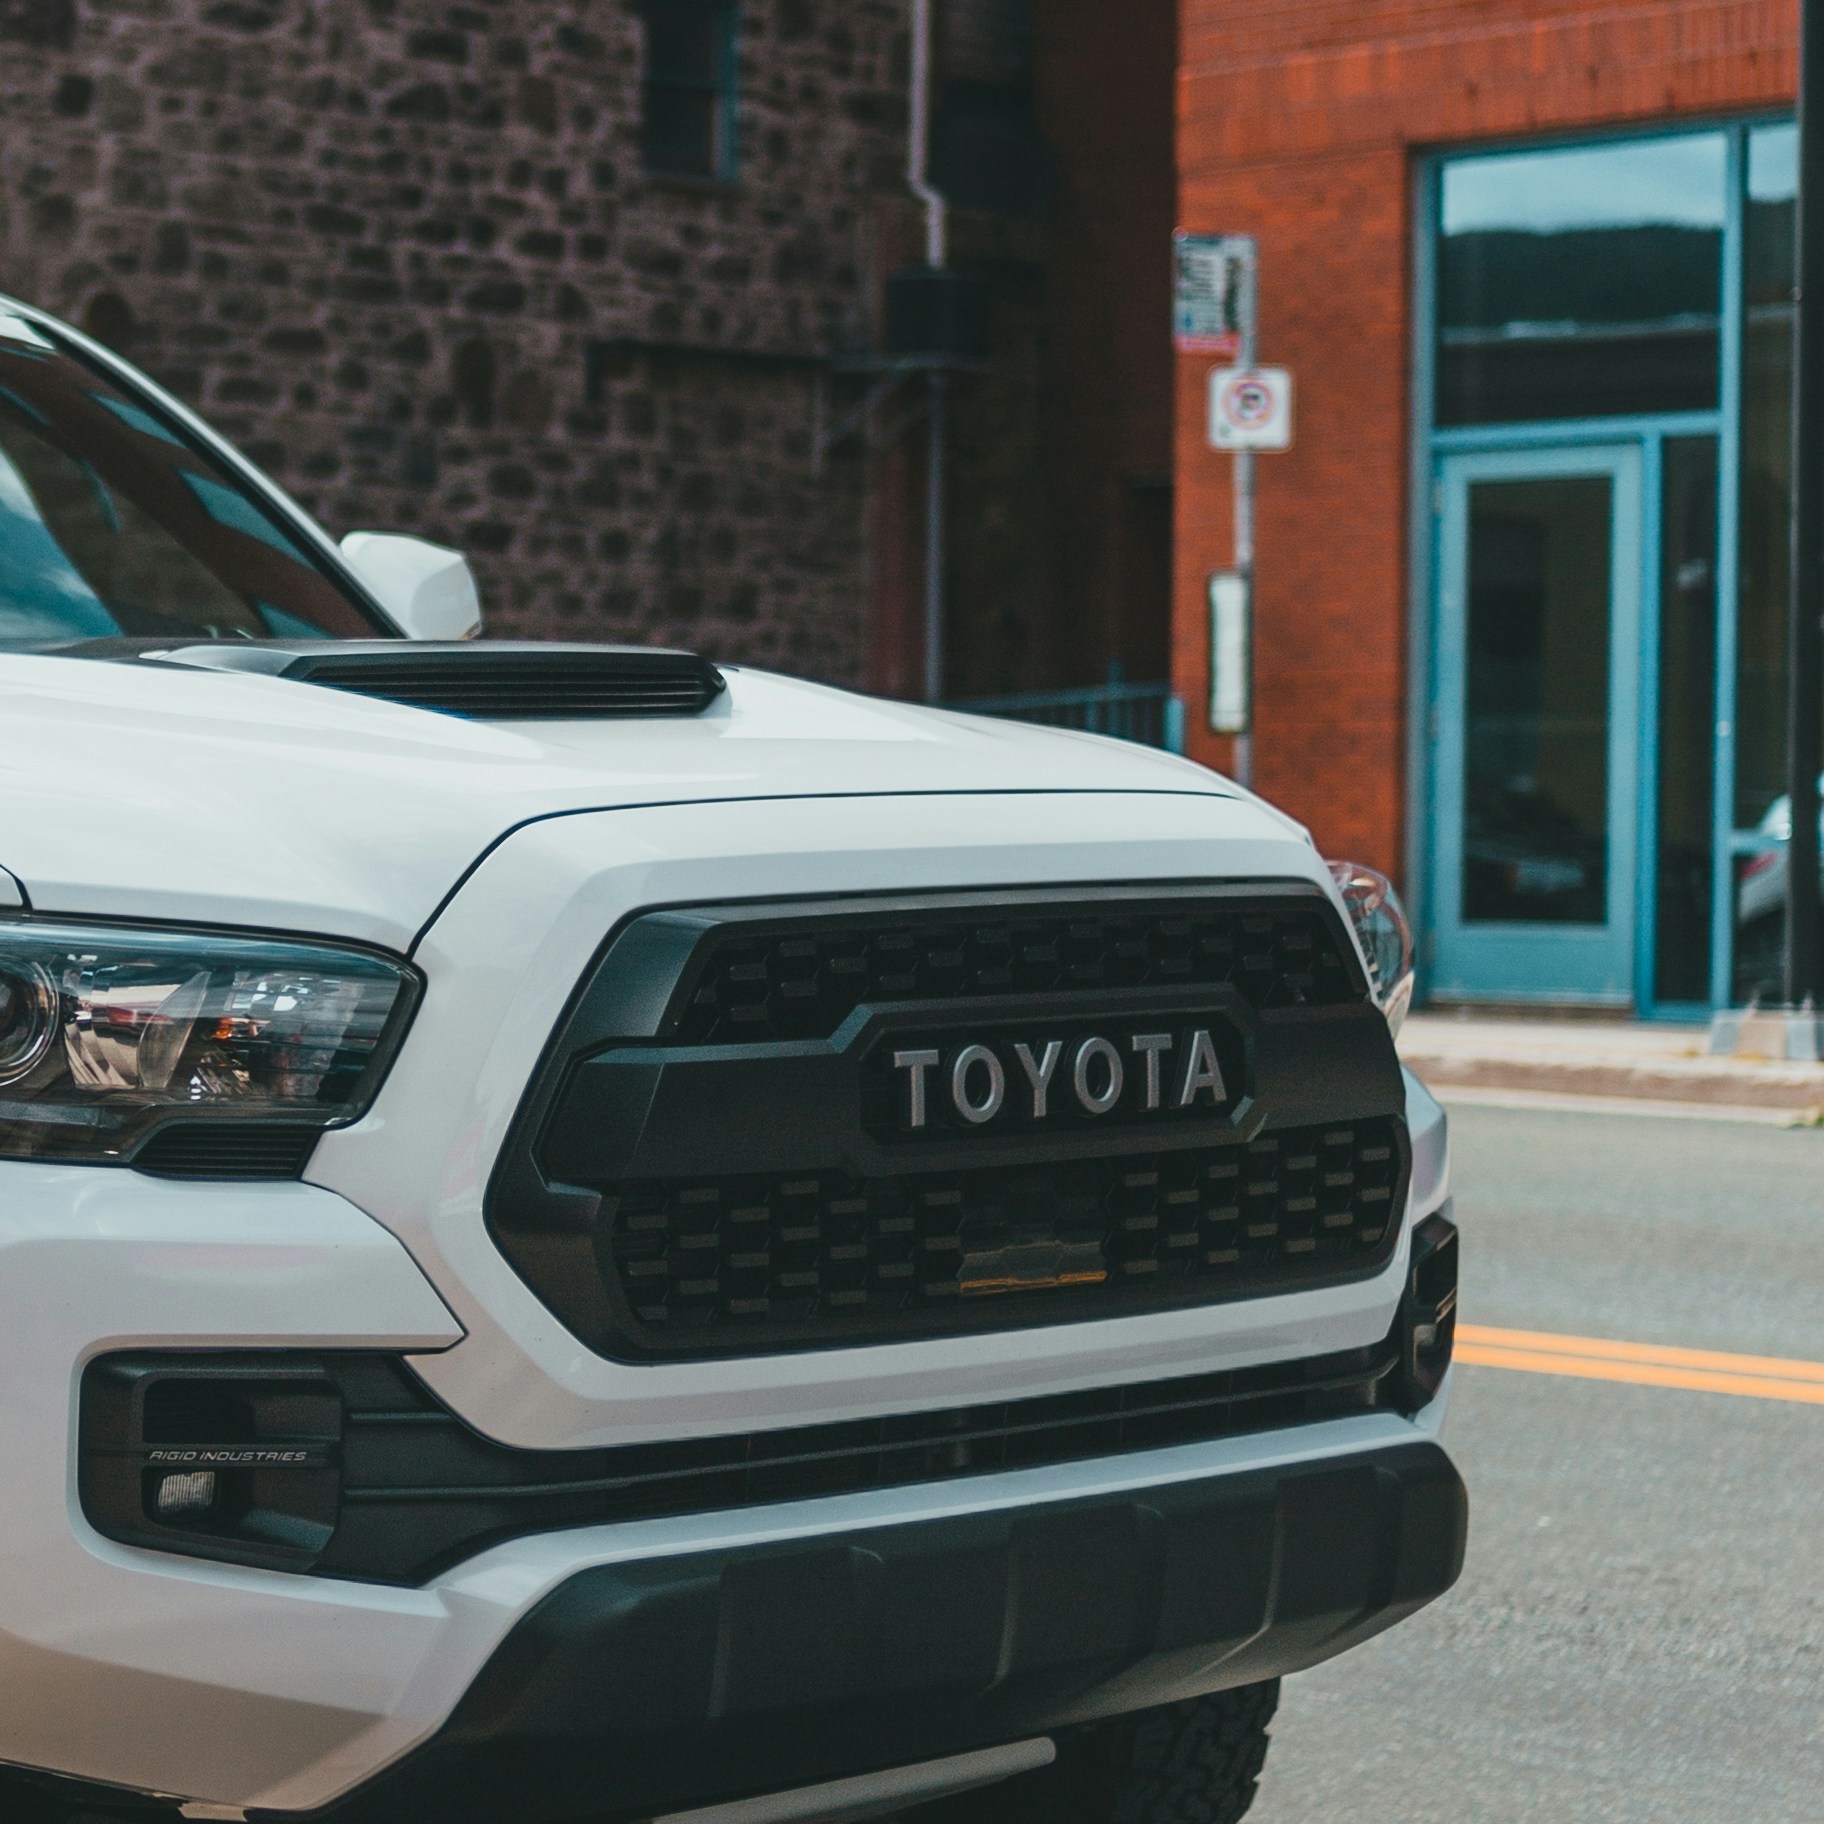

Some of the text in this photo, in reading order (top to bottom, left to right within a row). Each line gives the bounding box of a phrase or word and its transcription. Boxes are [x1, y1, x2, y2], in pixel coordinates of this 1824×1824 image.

[893, 1029, 1228, 1129] TOYOTA
[149, 1450, 308, 1461] RIGID INDUSTRIES
